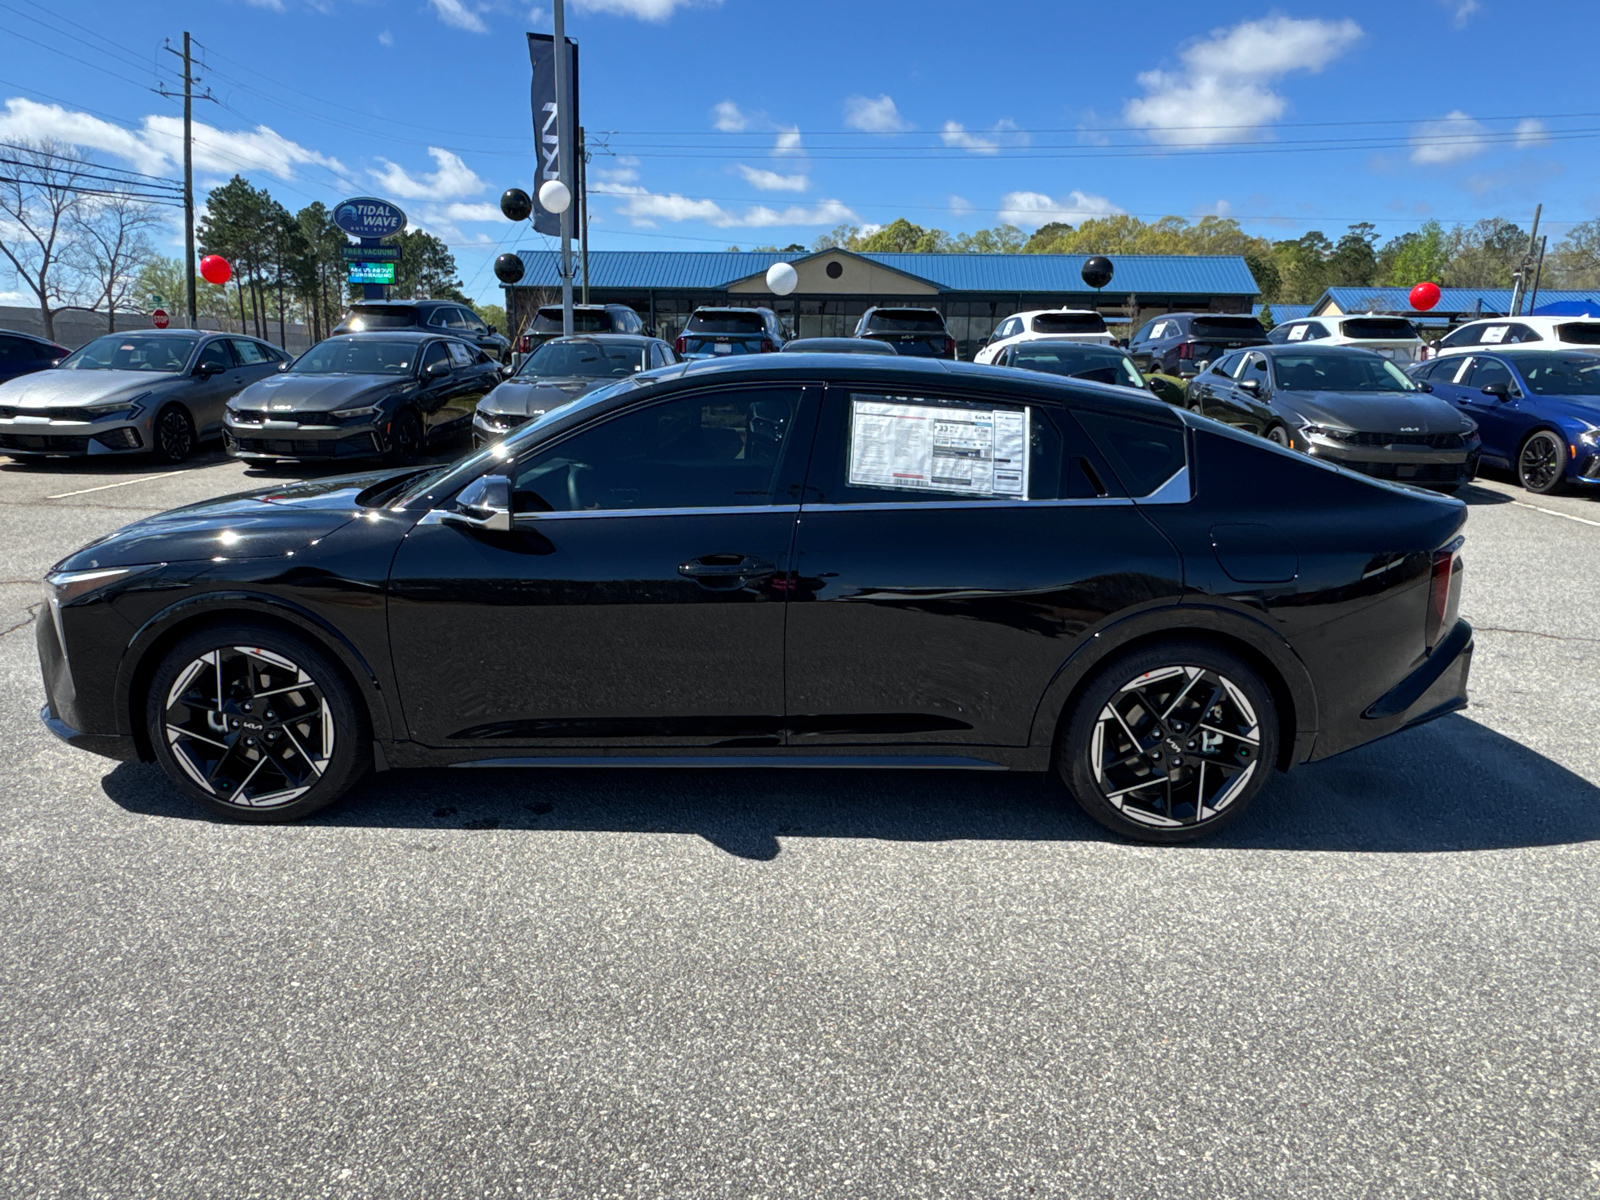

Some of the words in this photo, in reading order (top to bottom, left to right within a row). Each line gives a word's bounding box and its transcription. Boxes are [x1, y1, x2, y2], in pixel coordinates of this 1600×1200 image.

[357, 205, 391, 216] TIDAL
[363, 217, 398, 227] WAVE
[343, 247, 362, 255] FREE
[363, 248, 397, 256] VACUUMS
[154, 315, 168, 324] STOP
